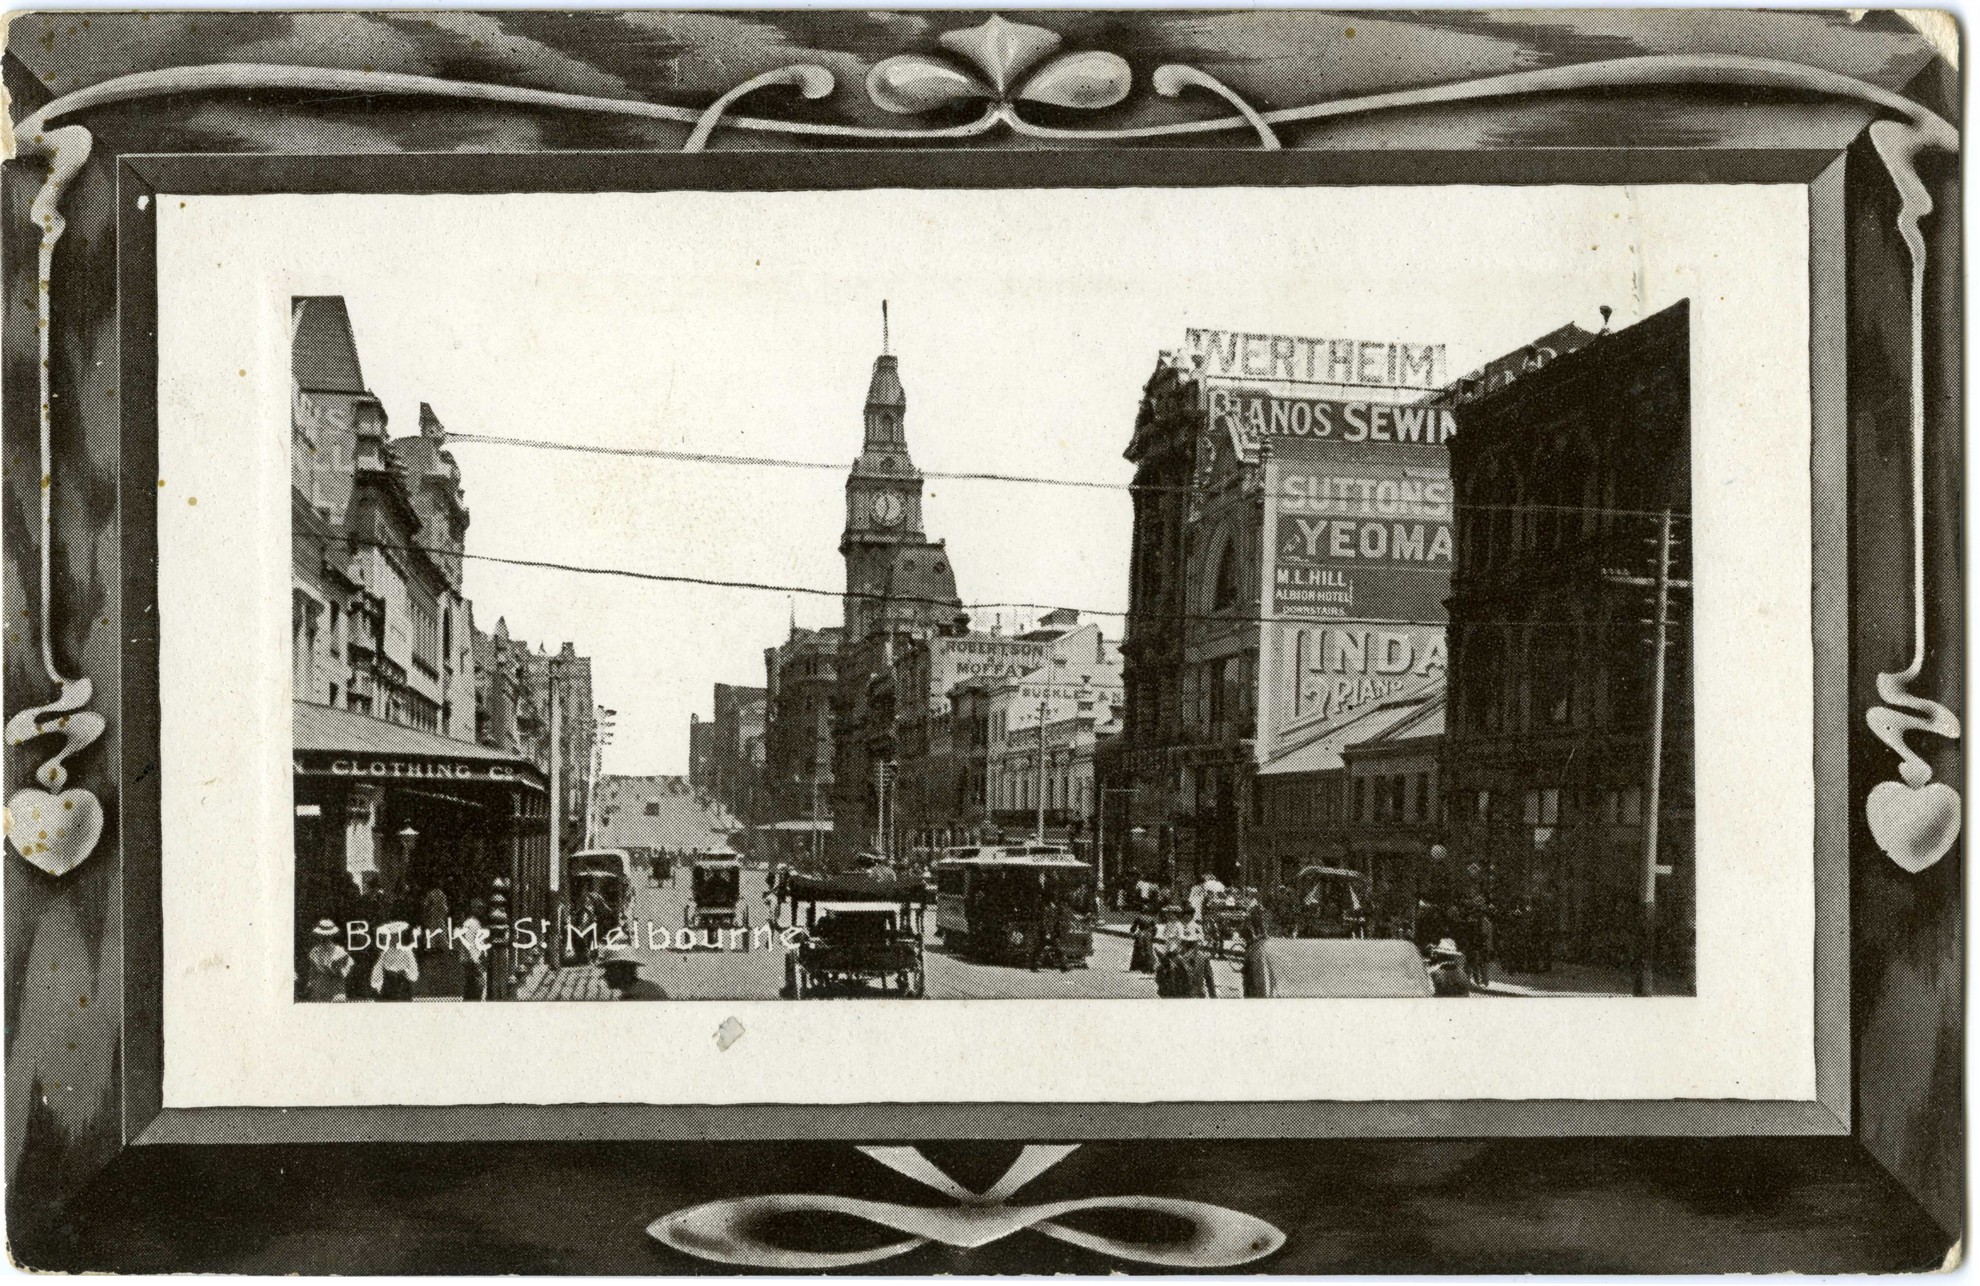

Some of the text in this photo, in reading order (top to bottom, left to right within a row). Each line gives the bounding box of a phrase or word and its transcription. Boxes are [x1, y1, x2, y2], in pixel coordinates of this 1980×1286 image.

[1186, 328, 1446, 387] WERTHEIM
[1343, 404, 1458, 443] SEWIN
[1281, 476, 1450, 517] SUTTONS
[1297, 519, 1452, 562] YEOMA
[1317, 590, 1350, 603] HOTEL
[945, 640, 1043, 657] ROBERTSON
[1022, 687, 1091, 701] BUCKLE
[332, 760, 472, 779] CLOTHING
